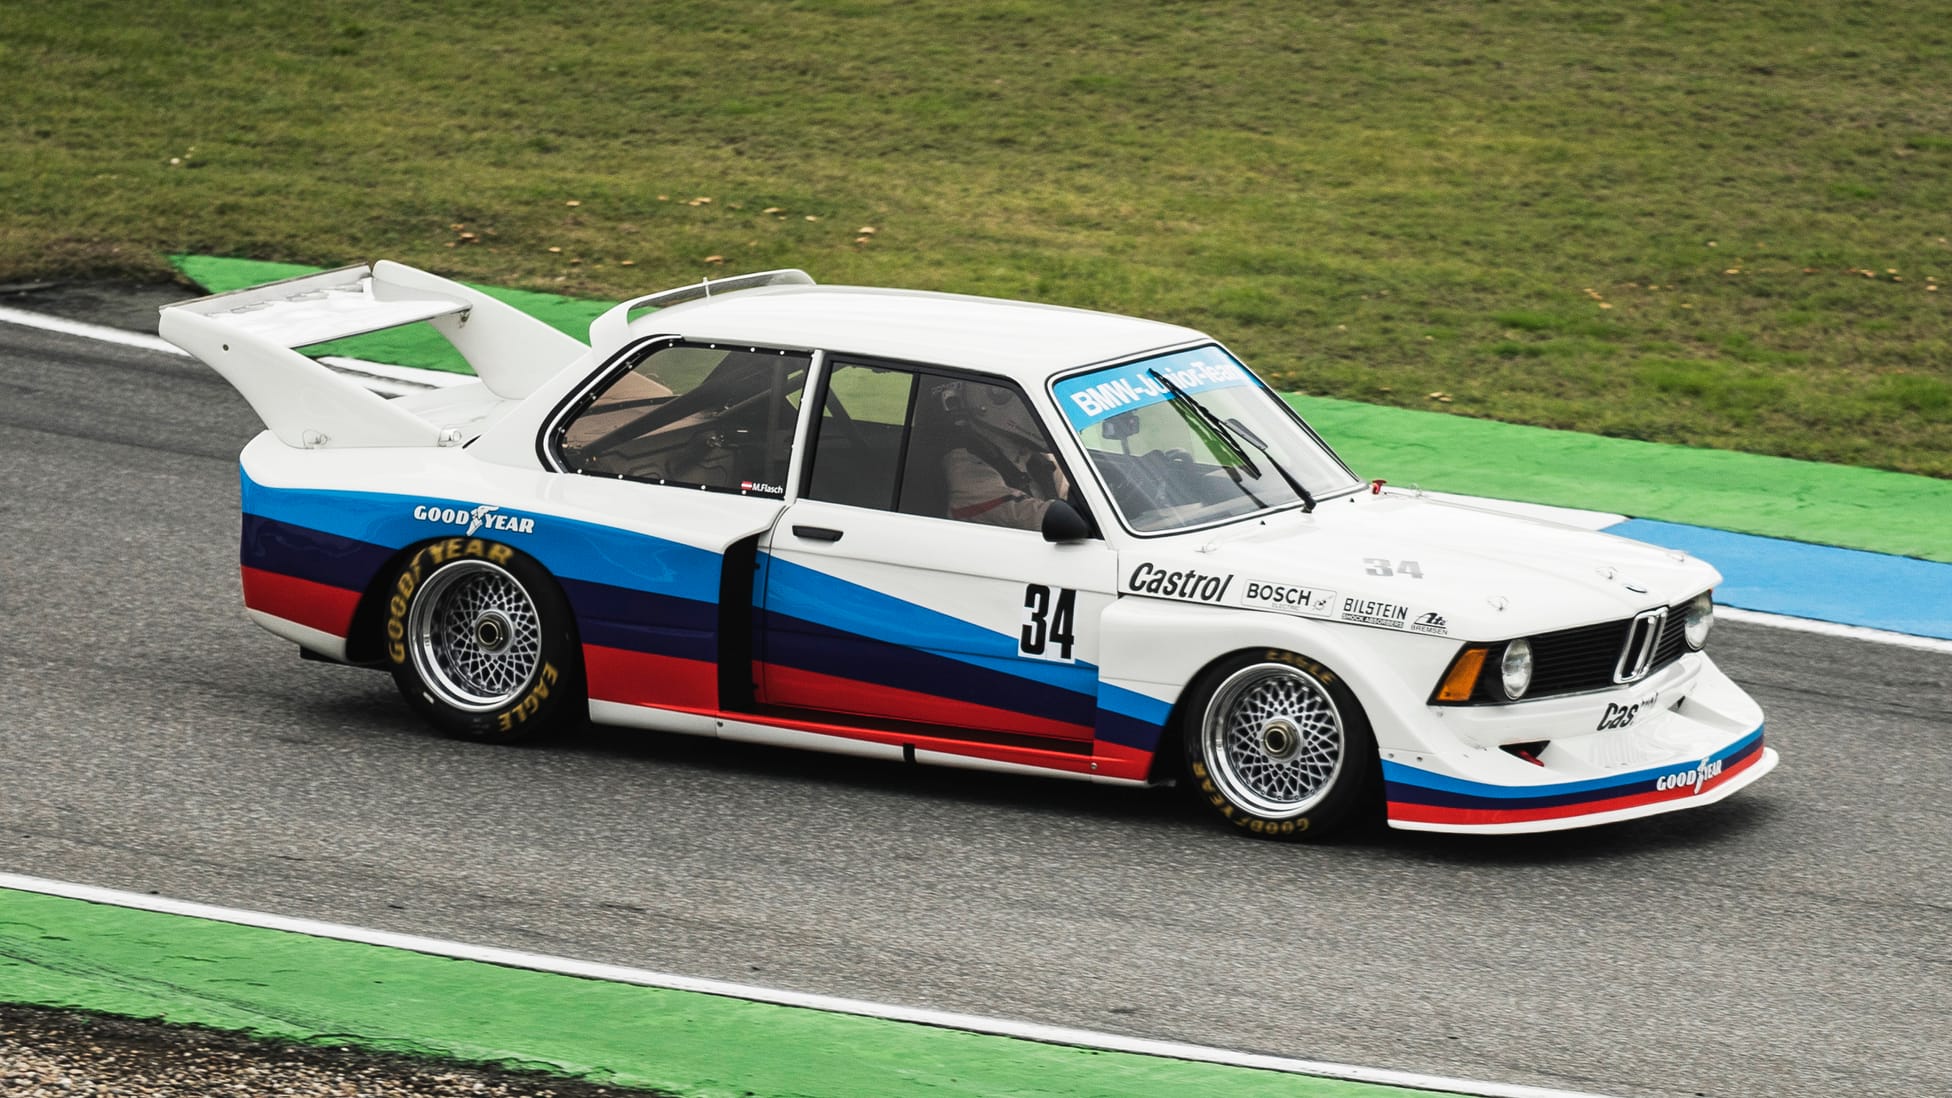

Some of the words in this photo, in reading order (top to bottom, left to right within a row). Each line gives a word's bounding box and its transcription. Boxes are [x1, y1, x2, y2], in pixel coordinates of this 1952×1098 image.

[752, 482, 783, 494] M.Flasch
[1362, 557, 1424, 579] 34
[1129, 562, 1234, 602] Castrol
[1246, 582, 1312, 606] BOSCH
[1343, 597, 1408, 620] BILSTEIN
[1020, 583, 1077, 660] 34
[1411, 625, 1448, 636] BREMSEN
[1264, 649, 1337, 685] EAGLE
[498, 662, 559, 732] EAGLE
